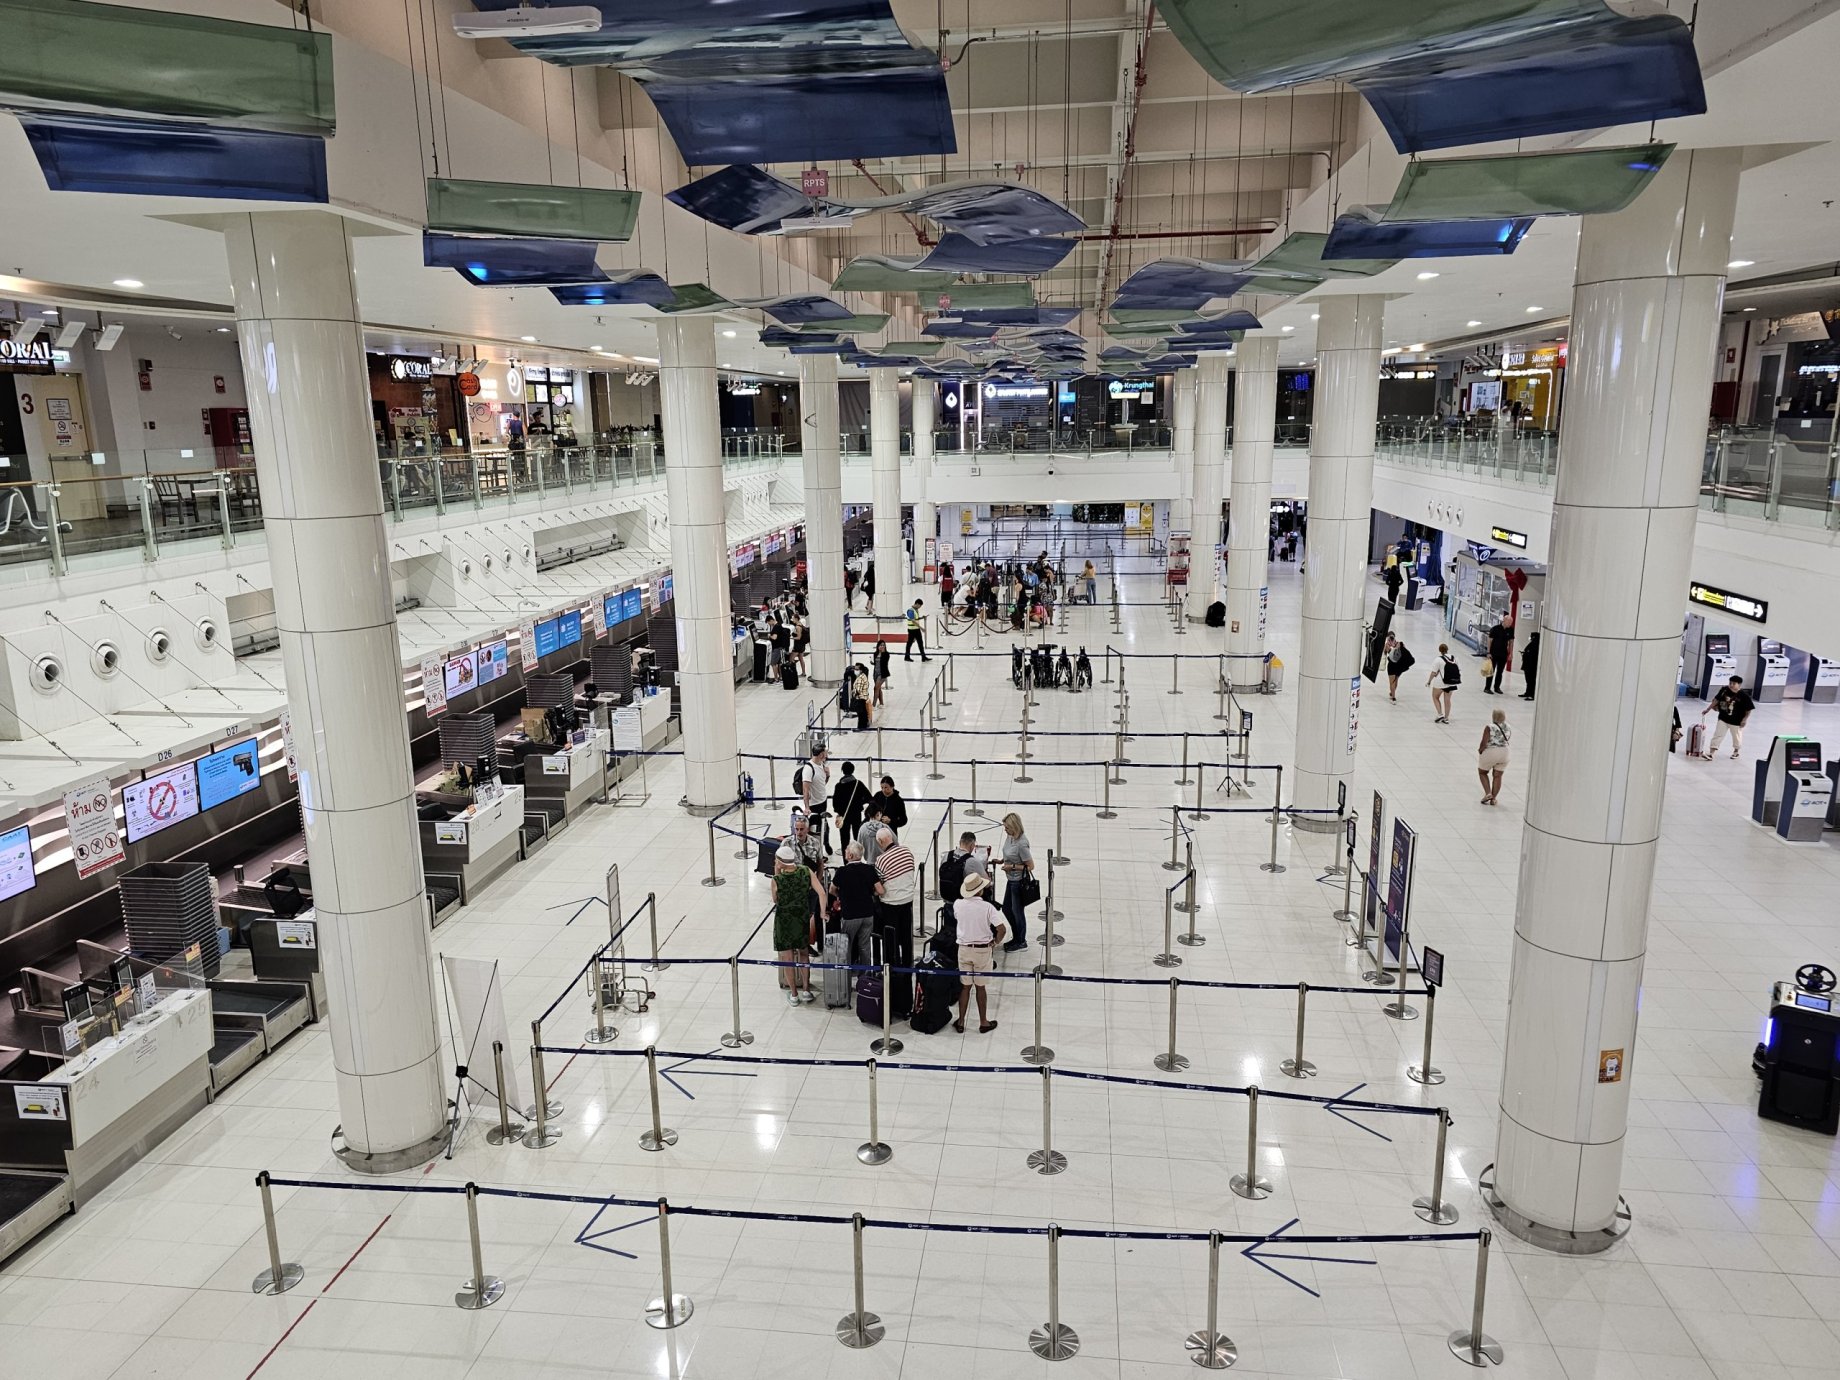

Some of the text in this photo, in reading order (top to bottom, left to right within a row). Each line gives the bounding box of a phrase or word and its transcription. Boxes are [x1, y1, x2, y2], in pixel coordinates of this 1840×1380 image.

[804, 178, 825, 187] RPTS
[0, 339, 54, 360] ORAL
[21, 393, 34, 415] 3
[226, 725, 239, 737] D27
[157, 749, 173, 762] D26
[71, 801, 92, 819] ห้าม
